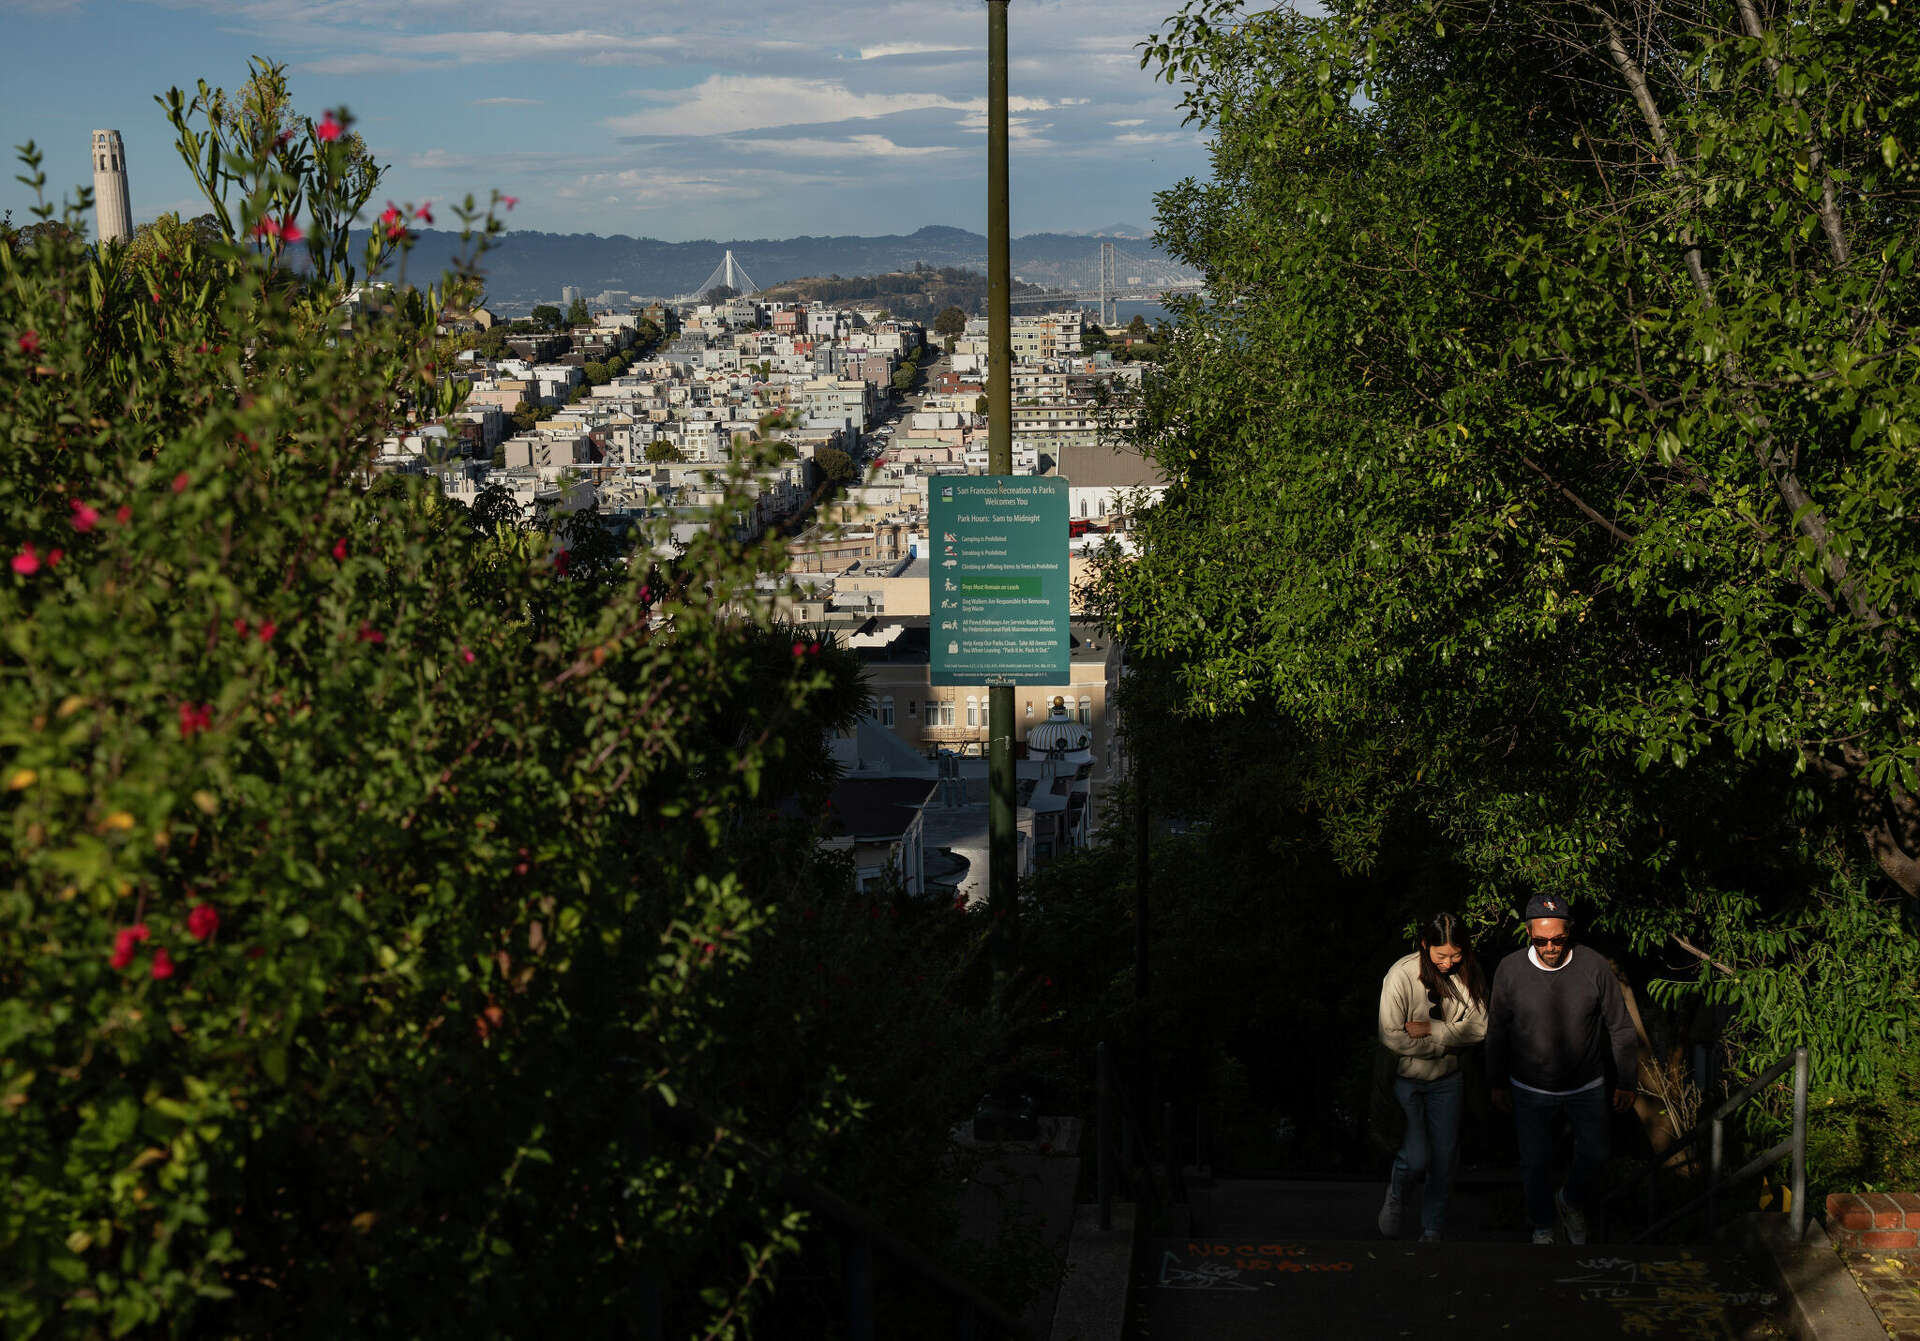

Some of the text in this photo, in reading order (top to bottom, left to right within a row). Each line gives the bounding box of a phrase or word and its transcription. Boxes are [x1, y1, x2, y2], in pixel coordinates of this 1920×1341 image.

[958, 486, 969, 494] San
[970, 486, 997, 494] Francisco
[1032, 486, 1037, 495] &
[1039, 486, 1055, 494] Parks
[1014, 515, 1040, 523] Midnight
